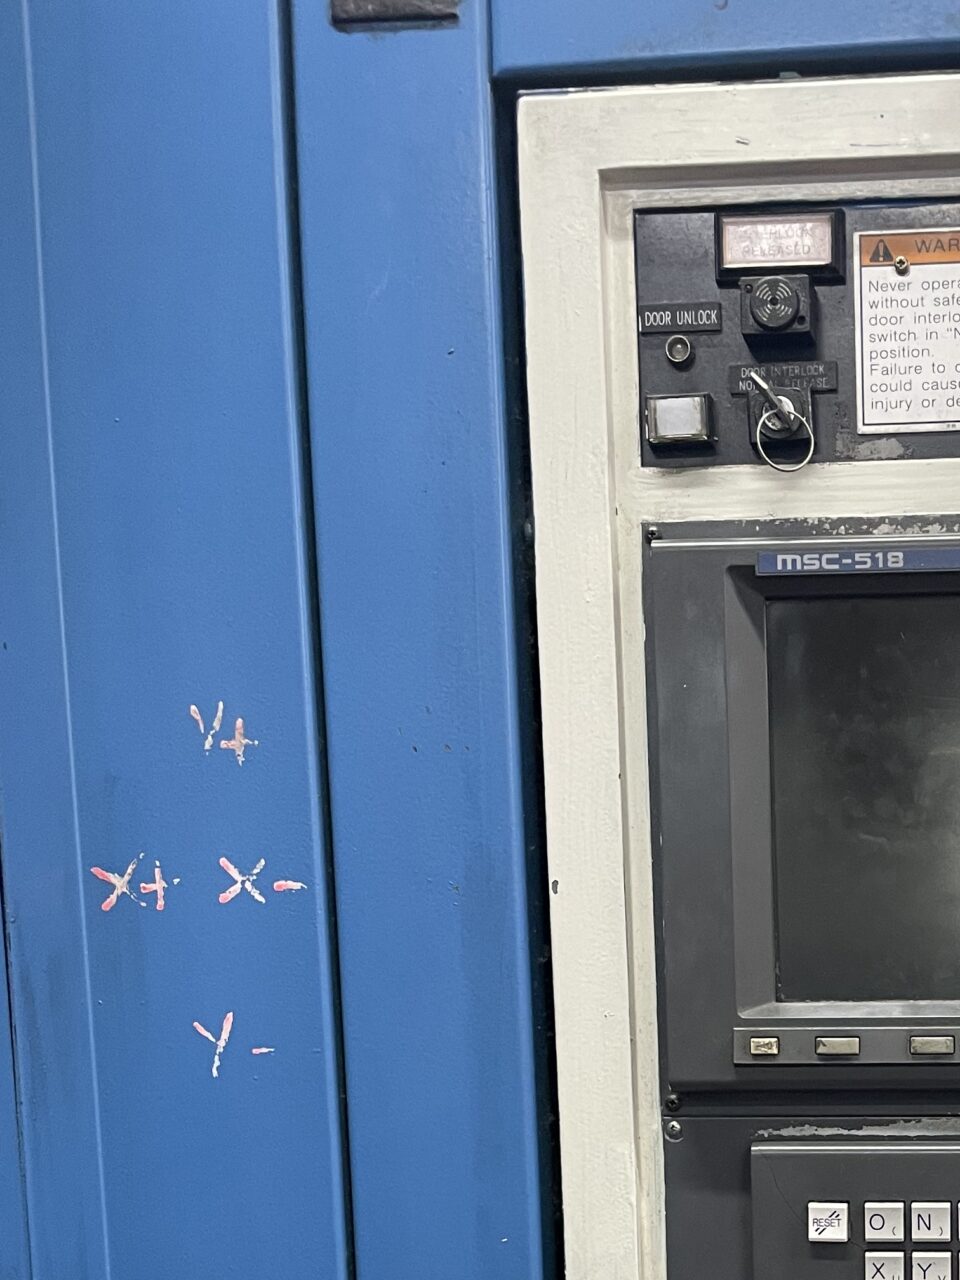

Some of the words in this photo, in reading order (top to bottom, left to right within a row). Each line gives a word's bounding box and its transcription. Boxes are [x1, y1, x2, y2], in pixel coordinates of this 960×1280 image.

[869, 280, 912, 292] Never
[869, 296, 924, 309] without
[645, 312, 671, 326] DOOR
[677, 310, 718, 324] UNLOCK
[869, 315, 904, 325] door
[869, 331, 916, 342] switch
[926, 330, 938, 340] in
[870, 347, 934, 361] position.
[870, 364, 922, 376] Failure
[932, 363, 945, 373] to
[870, 380, 912, 392] could
[871, 398, 912, 412] injury
[922, 398, 935, 408] or
[813, 1218, 841, 1228] RESET
